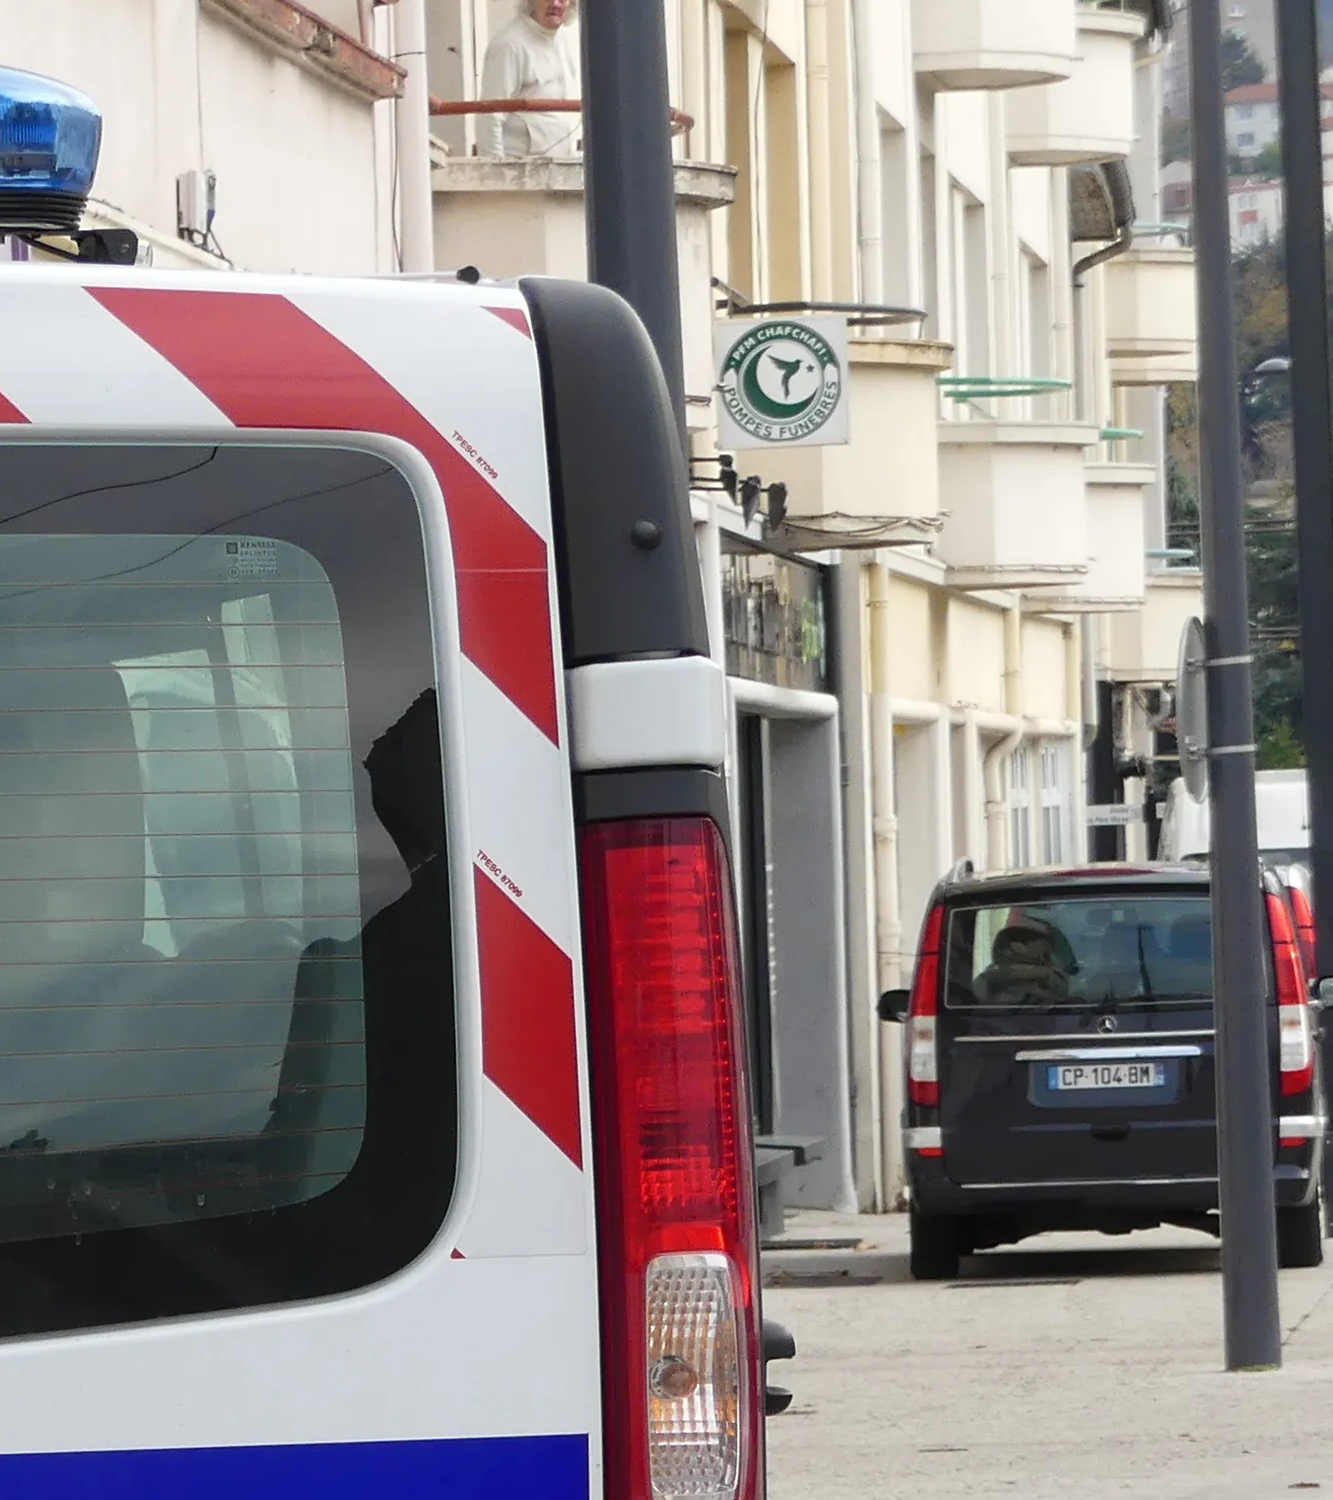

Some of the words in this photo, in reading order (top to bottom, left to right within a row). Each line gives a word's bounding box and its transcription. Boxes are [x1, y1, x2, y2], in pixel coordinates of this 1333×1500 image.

[727, 386, 773, 438] POMPES
[779, 381, 837, 438] FUNEBRES
[452, 430, 478, 457] TPESC
[476, 849, 502, 877] TPESC
